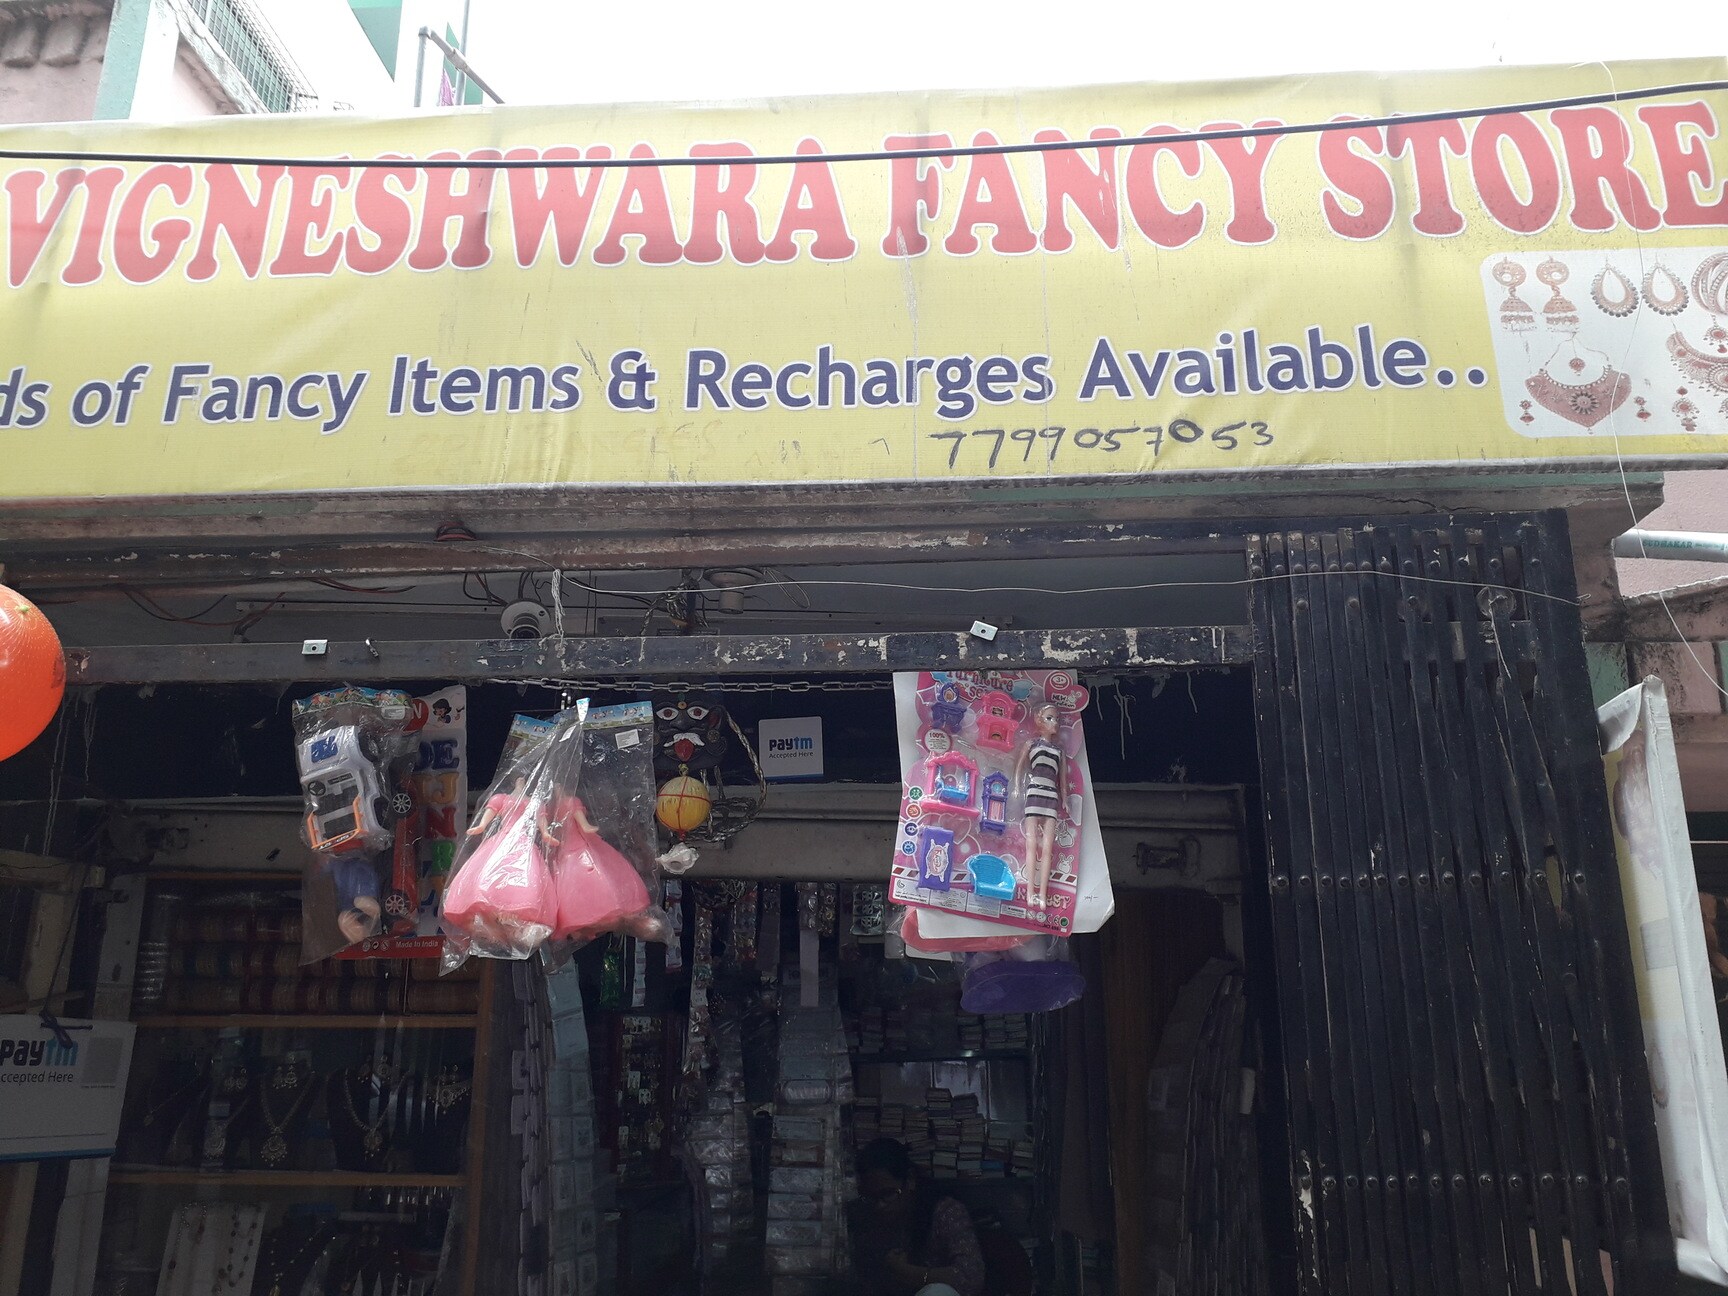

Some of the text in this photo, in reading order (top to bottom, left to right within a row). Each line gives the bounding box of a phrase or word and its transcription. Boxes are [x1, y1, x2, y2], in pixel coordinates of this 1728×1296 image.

[7, 100, 1728, 286] VIGNESHWARA FANCY STORE
[71, 365, 150, 425] of
[163, 363, 368, 433] Fancy
[388, 354, 581, 414] Items
[607, 349, 657, 410] &
[685, 345, 1049, 420] Recharges
[1, 1072, 74, 1084] ccepted Here
